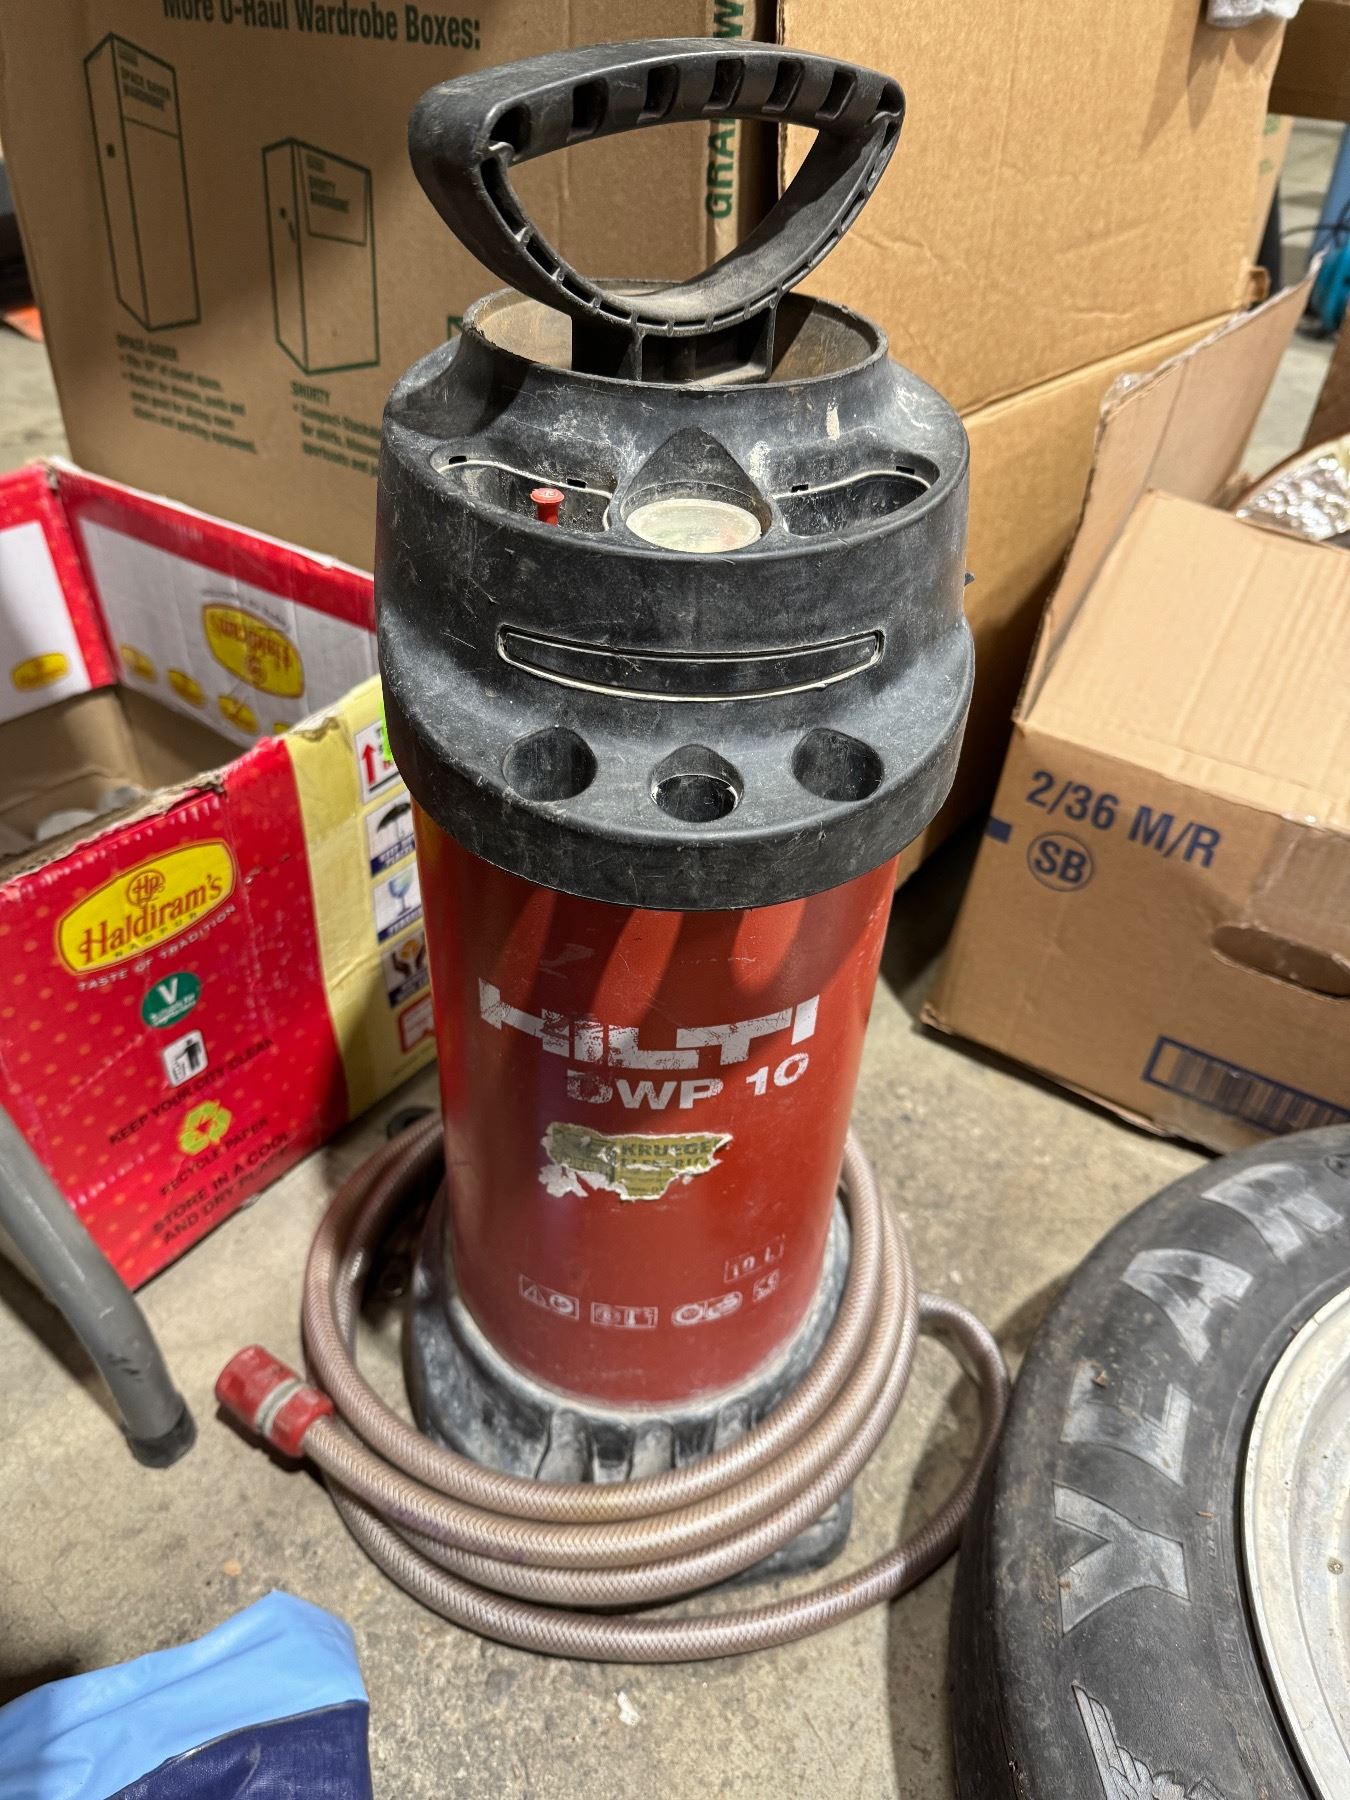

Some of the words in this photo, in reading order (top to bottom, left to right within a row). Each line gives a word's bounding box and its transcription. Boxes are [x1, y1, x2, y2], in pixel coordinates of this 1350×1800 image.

[295, 0, 399, 41] Wardrobe
[404, 5, 481, 50] Boxes:
[705, 118, 736, 219] GRA
[1026, 770, 1120, 832] 2/36
[1127, 804, 1222, 869] M/R
[1033, 838, 1088, 885] SB
[77, 969, 129, 992] TASTE
[134, 957, 154, 974] OF
[158, 904, 237, 959] TRADITION
[79, 873, 223, 965] Haldiram's
[158, 977, 178, 1005] V
[478, 976, 820, 1070] HILTI
[566, 1068, 725, 1110] DWP
[745, 1051, 810, 1096] 10
[109, 1114, 149, 1145] KEEP
[151, 1087, 192, 1117] YOUR
[163, 1211, 200, 1243] AND
